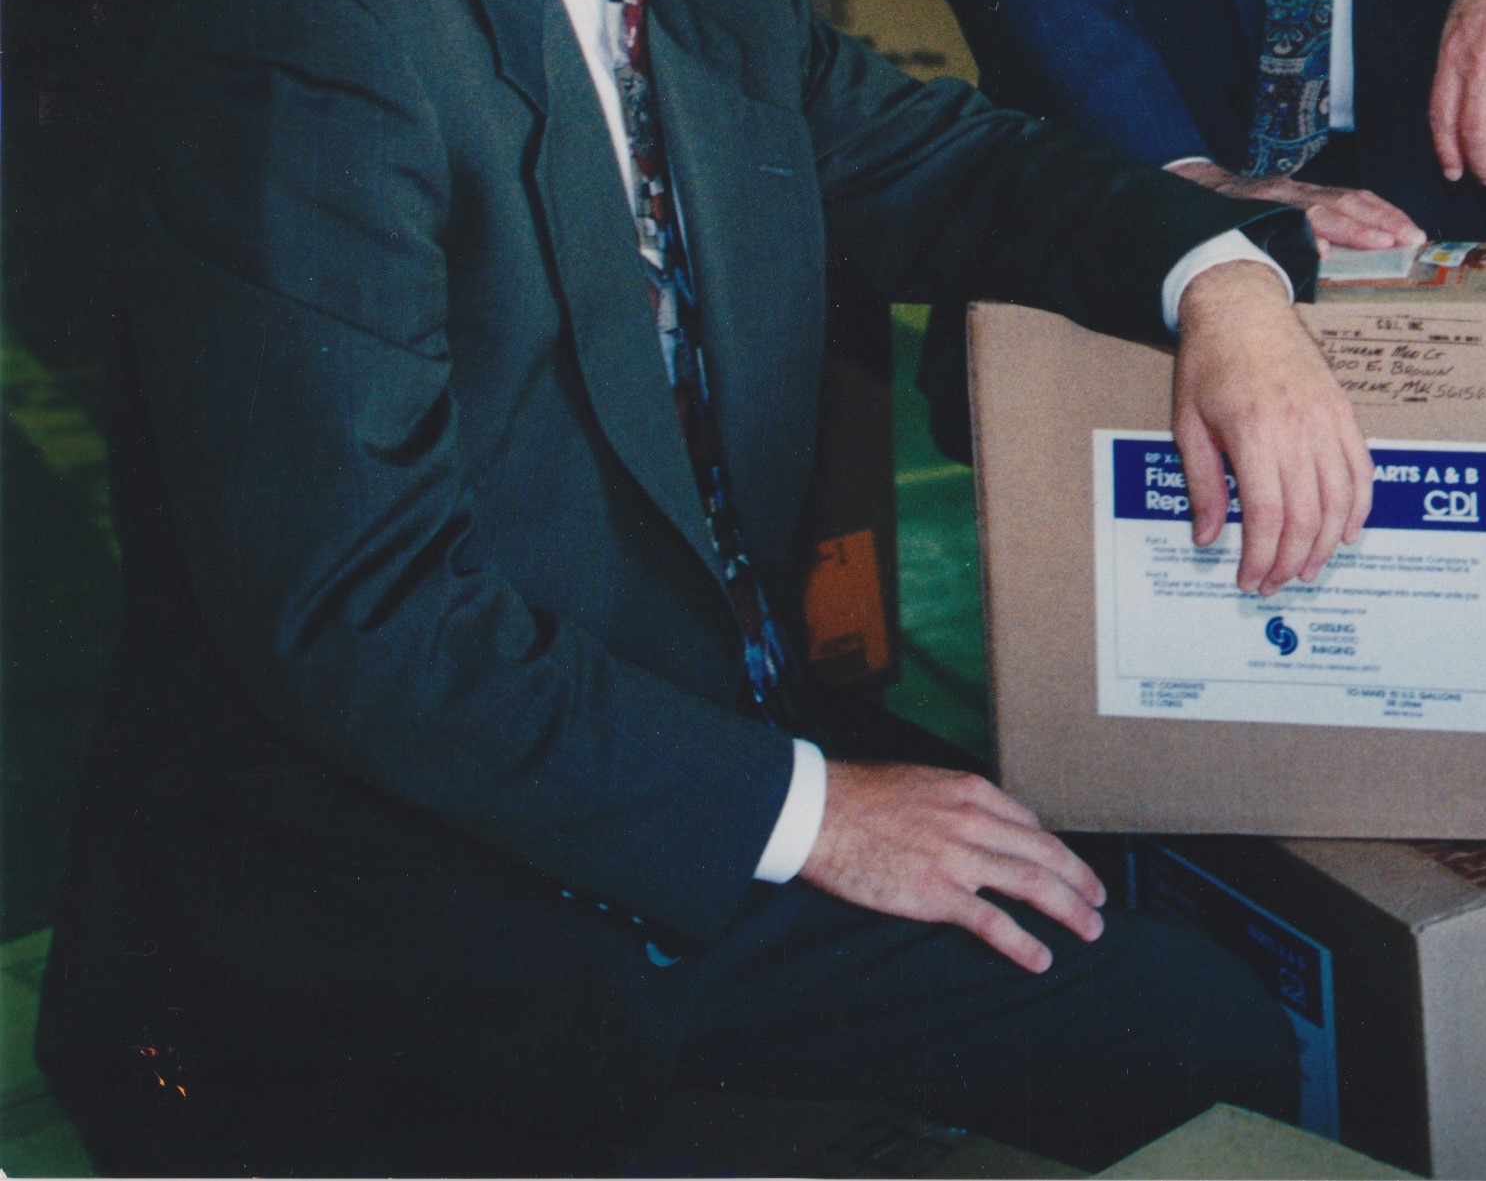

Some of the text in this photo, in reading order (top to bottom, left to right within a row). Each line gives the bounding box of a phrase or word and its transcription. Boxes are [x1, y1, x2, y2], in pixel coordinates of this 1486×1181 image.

[1145, 465, 1479, 489] Fixe ARTS A & B
[1423, 489, 1478, 517] CDI
